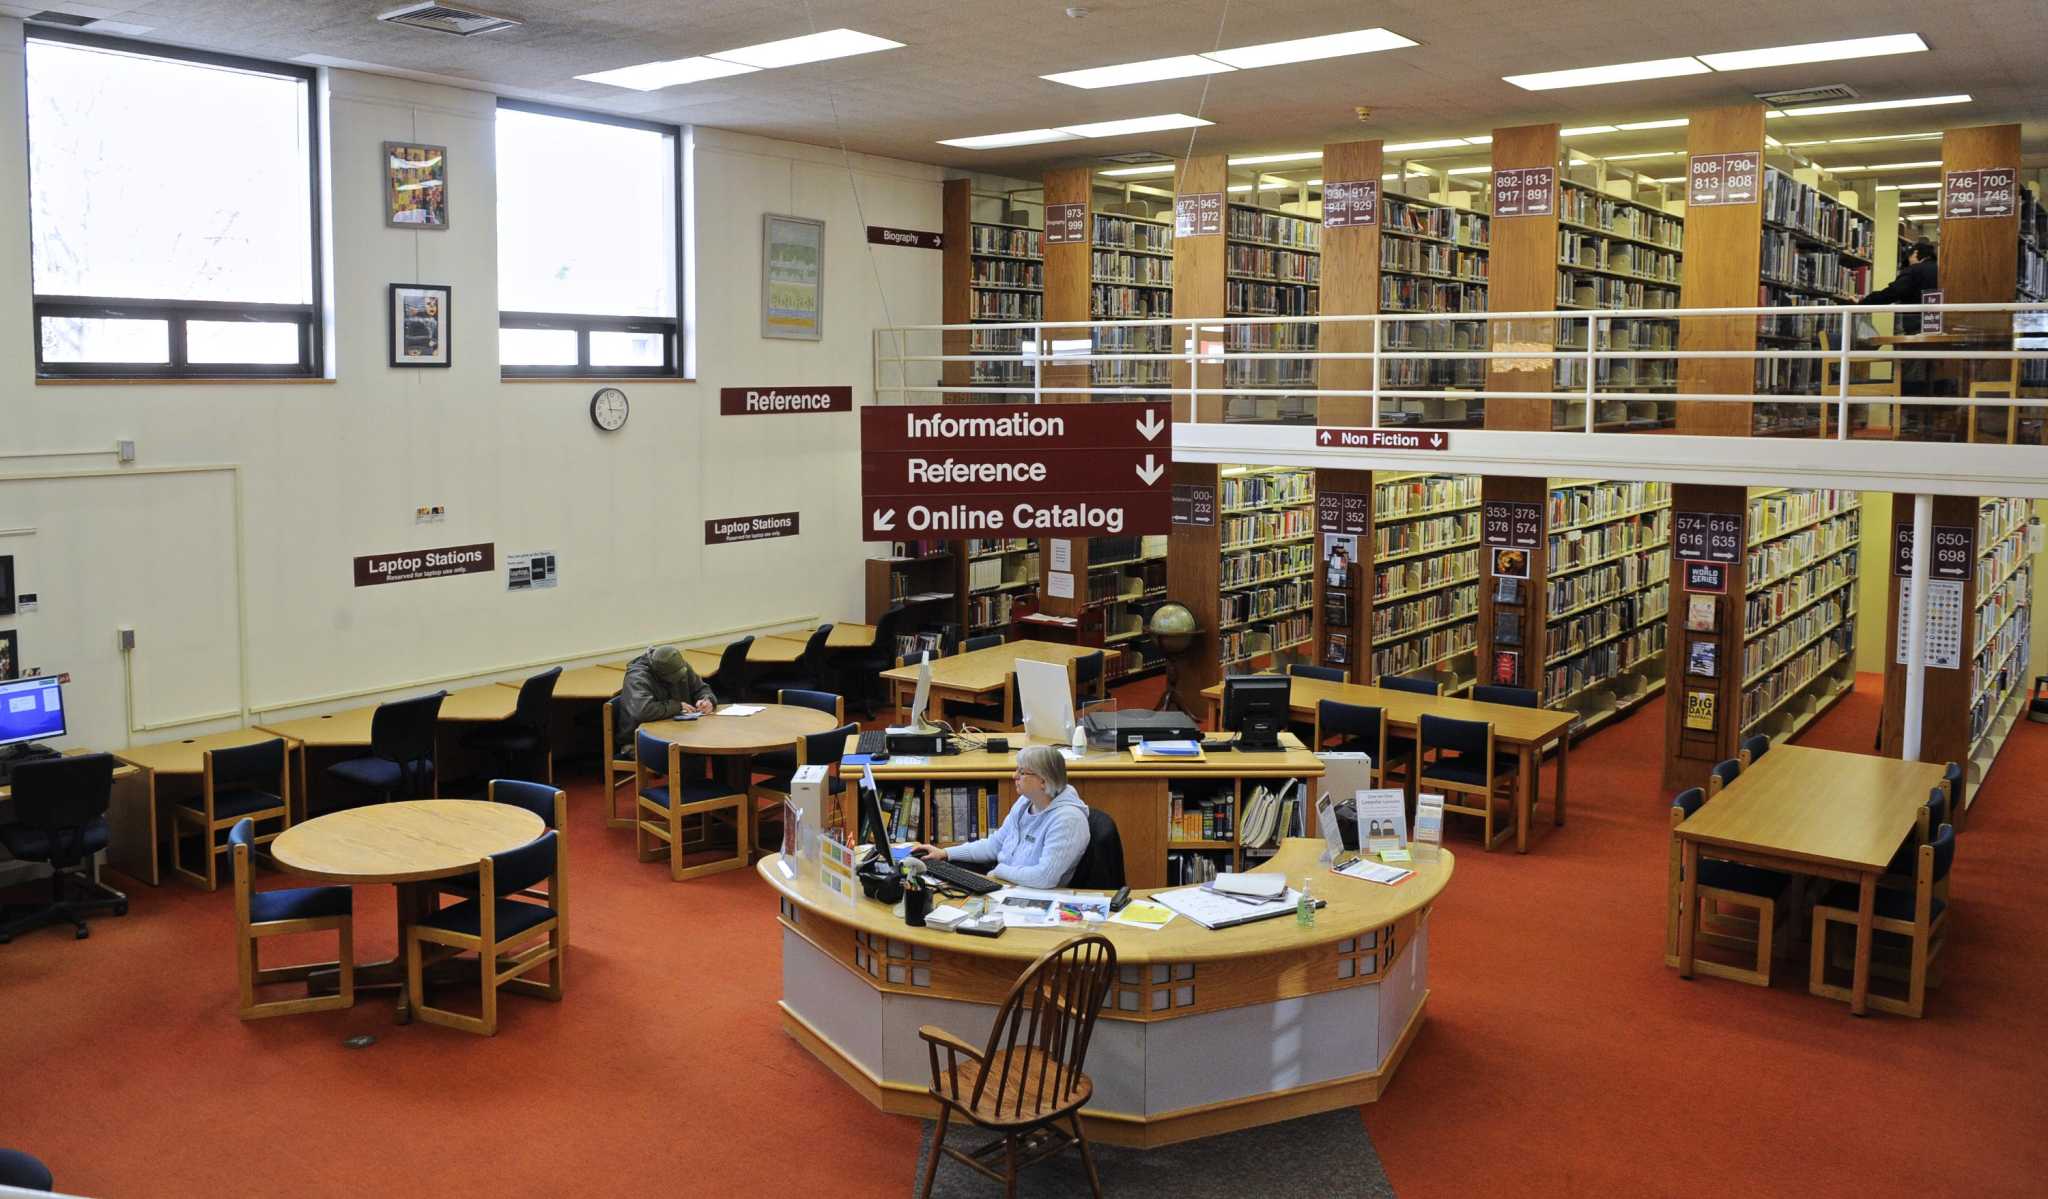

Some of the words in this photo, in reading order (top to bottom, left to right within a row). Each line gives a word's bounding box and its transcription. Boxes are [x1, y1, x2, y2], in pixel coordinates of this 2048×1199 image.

[1693, 162, 1721, 174] 808-
[1726, 159, 1756, 172] 790-
[1496, 176, 1522, 188] 892-
[1525, 174, 1551, 186] 813-
[1695, 177, 1719, 190] 813
[1728, 175, 1752, 188] 808
[1948, 177, 1978, 189] 746-
[1982, 175, 2012, 187] 700-
[1352, 186, 1375, 198] 917-
[1498, 190, 1520, 202] 917
[1527, 189, 1548, 200] 891
[1951, 192, 1975, 203] 790
[1984, 190, 2009, 201] 746
[1200, 199, 1220, 209] 945-
[1328, 201, 1346, 212] 944
[1353, 200, 1372, 211] 929
[1067, 209, 1084, 218] 973-
[1201, 212, 1219, 222] 972
[883, 230, 919, 245] Biography
[746, 390, 831, 411] Reference
[907, 412, 1064, 438] Information
[1341, 432, 1368, 445] Non
[1373, 433, 1419, 446] Fiction
[908, 458, 1047, 483] Reference
[1193, 490, 1213, 500] 000-
[1194, 503, 1211, 513] 232
[1320, 497, 1341, 508] 232-
[1344, 498, 1367, 509] 327-
[907, 504, 1005, 532] Online
[1012, 502, 1124, 533] Catalog
[1321, 510, 1339, 521] 327
[1346, 512, 1365, 523] 352
[1487, 507, 1511, 518] 353-
[1515, 508, 1539, 520] 378-
[715, 522, 750, 535] Laptop
[752, 517, 792, 530] Stations
[1488, 521, 1509, 533] 378
[1516, 523, 1537, 534] 574
[1678, 518, 1706, 530] 574-
[1710, 520, 1739, 532] 616-
[1680, 533, 1703, 545] 616
[1712, 535, 1736, 548] 635
[1937, 533, 1969, 546] 650-
[1938, 549, 1966, 563] 698
[369, 557, 422, 575] Laptop
[425, 550, 482, 567] Stations
[386, 572, 414, 581] Reserved
[1692, 568, 1719, 576] WORLD
[1692, 575, 1718, 585] SERIES
[1690, 696, 1712, 708] BIG
[1689, 707, 1712, 716] DATA
